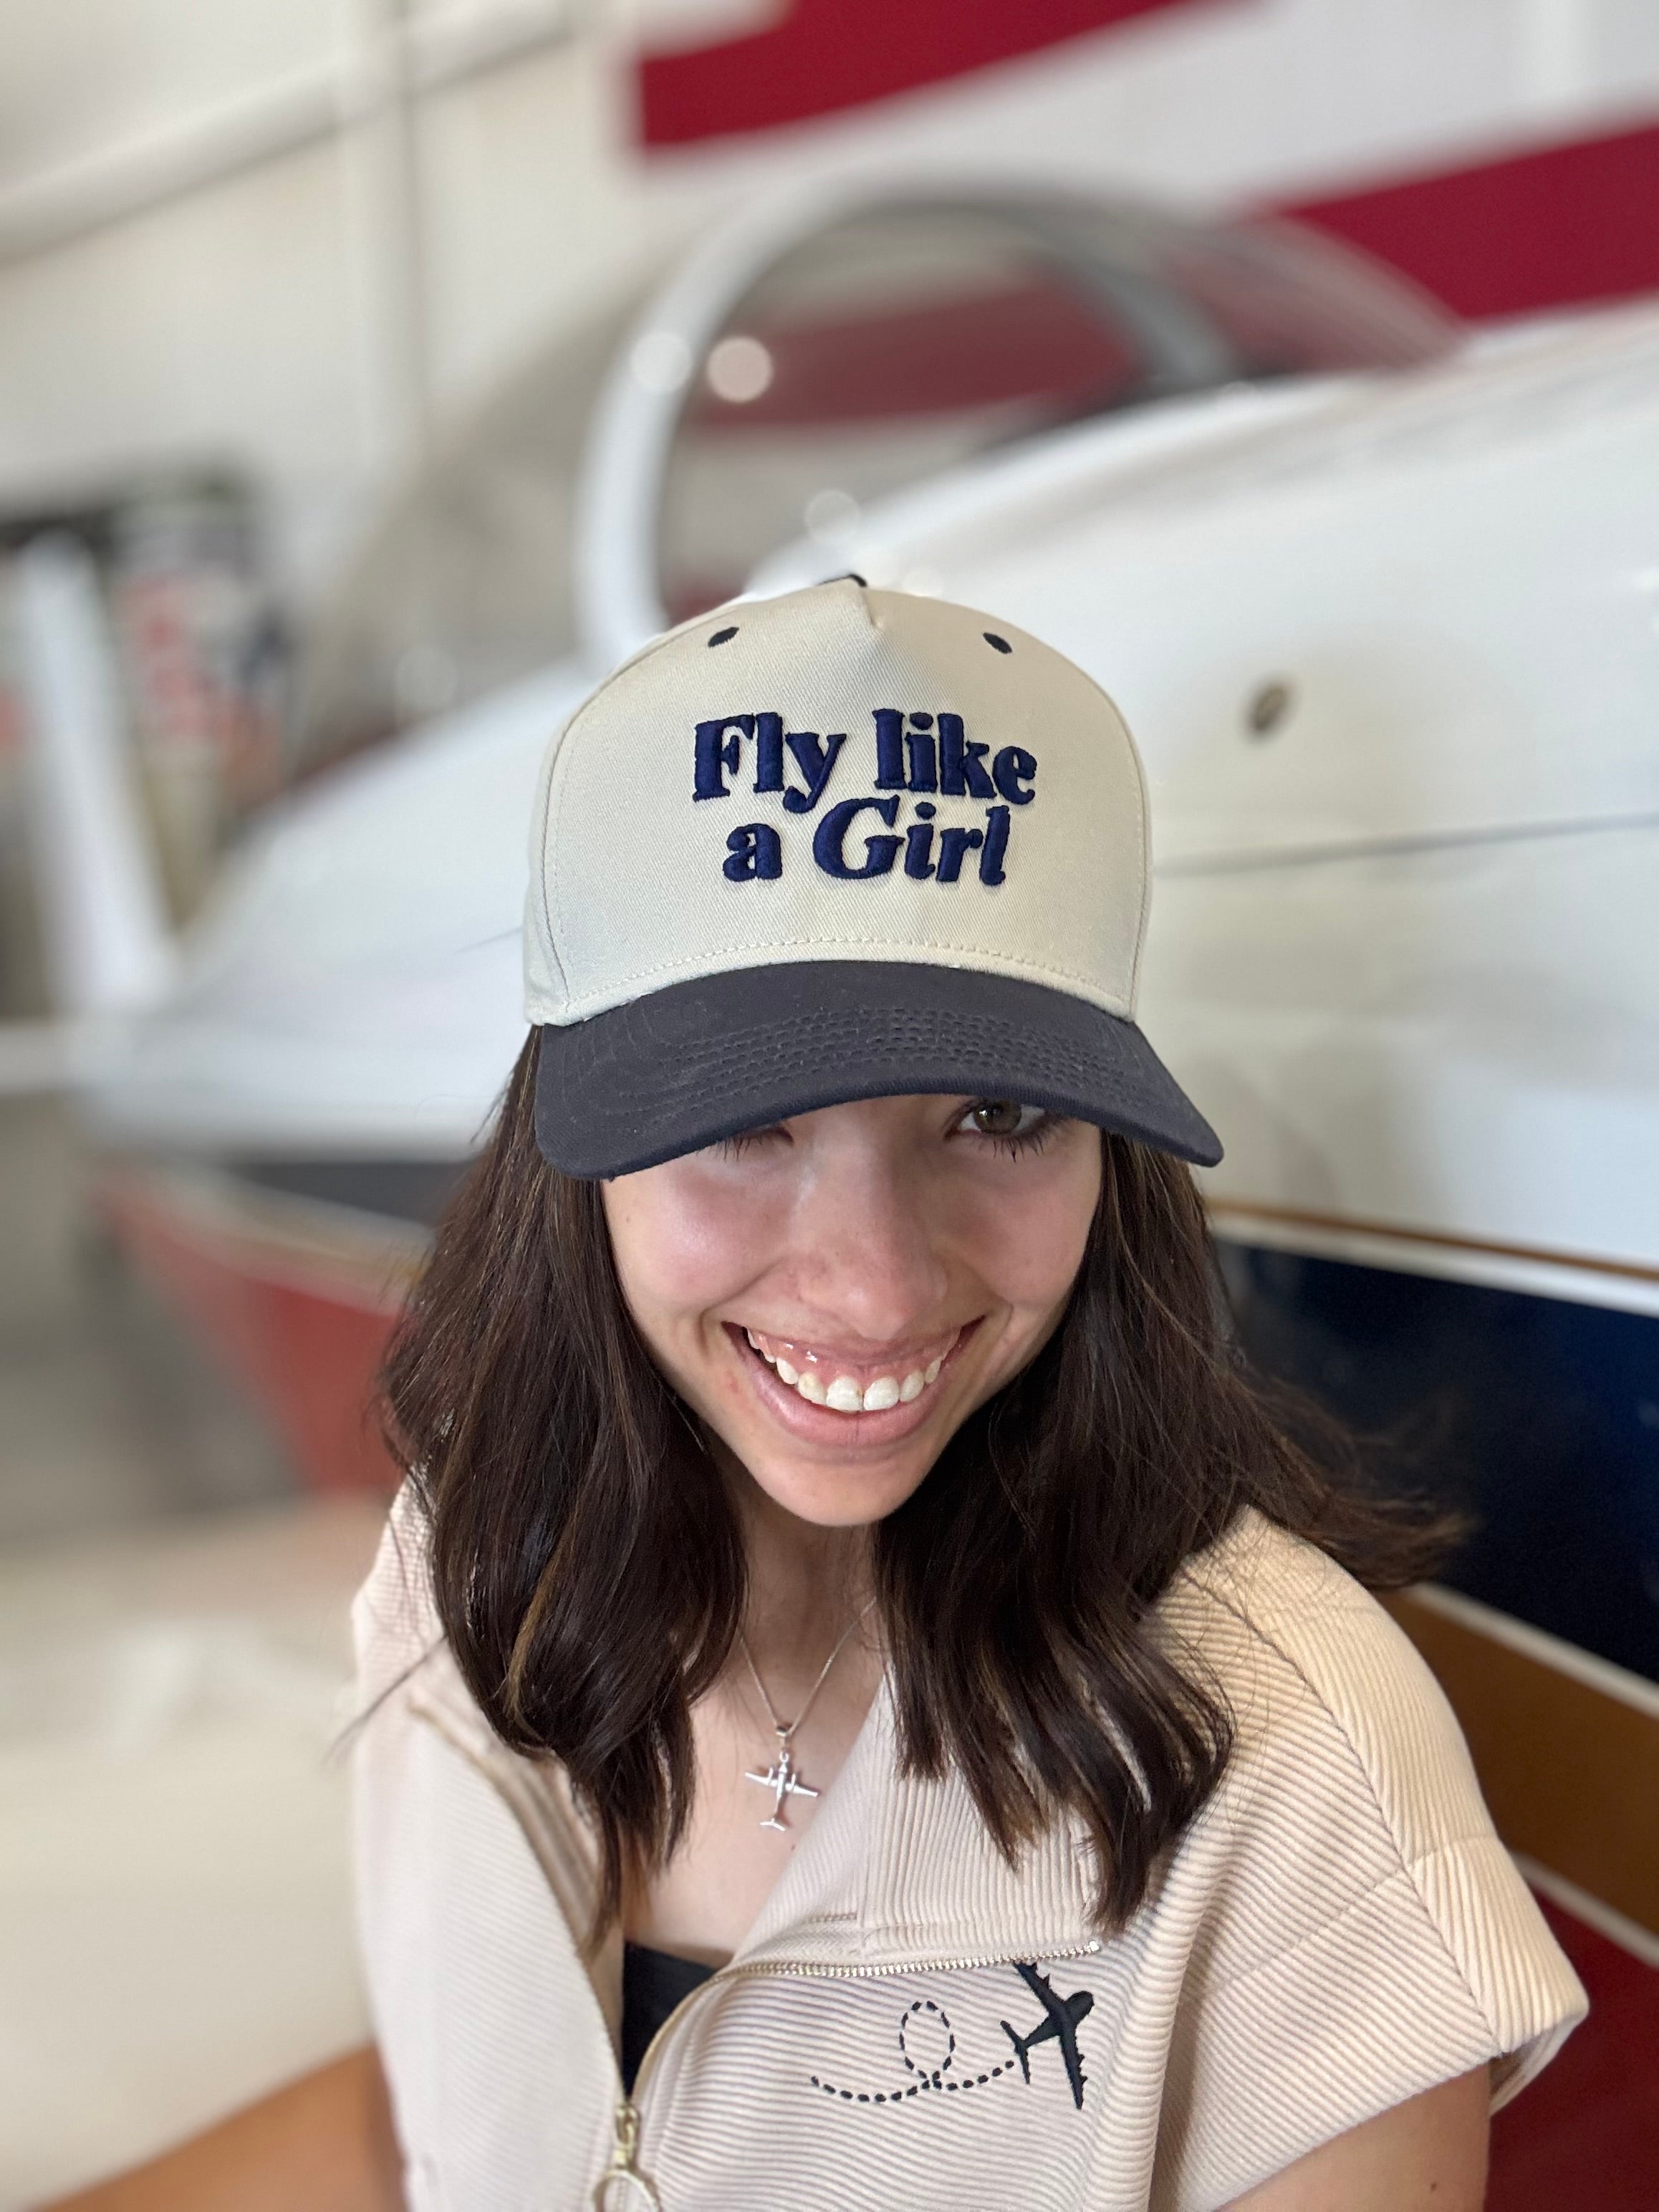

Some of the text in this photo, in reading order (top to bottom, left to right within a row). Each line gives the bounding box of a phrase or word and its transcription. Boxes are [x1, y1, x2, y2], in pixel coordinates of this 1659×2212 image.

[692, 708, 1038, 814] Fly like
[722, 794, 1011, 886] a Girl
